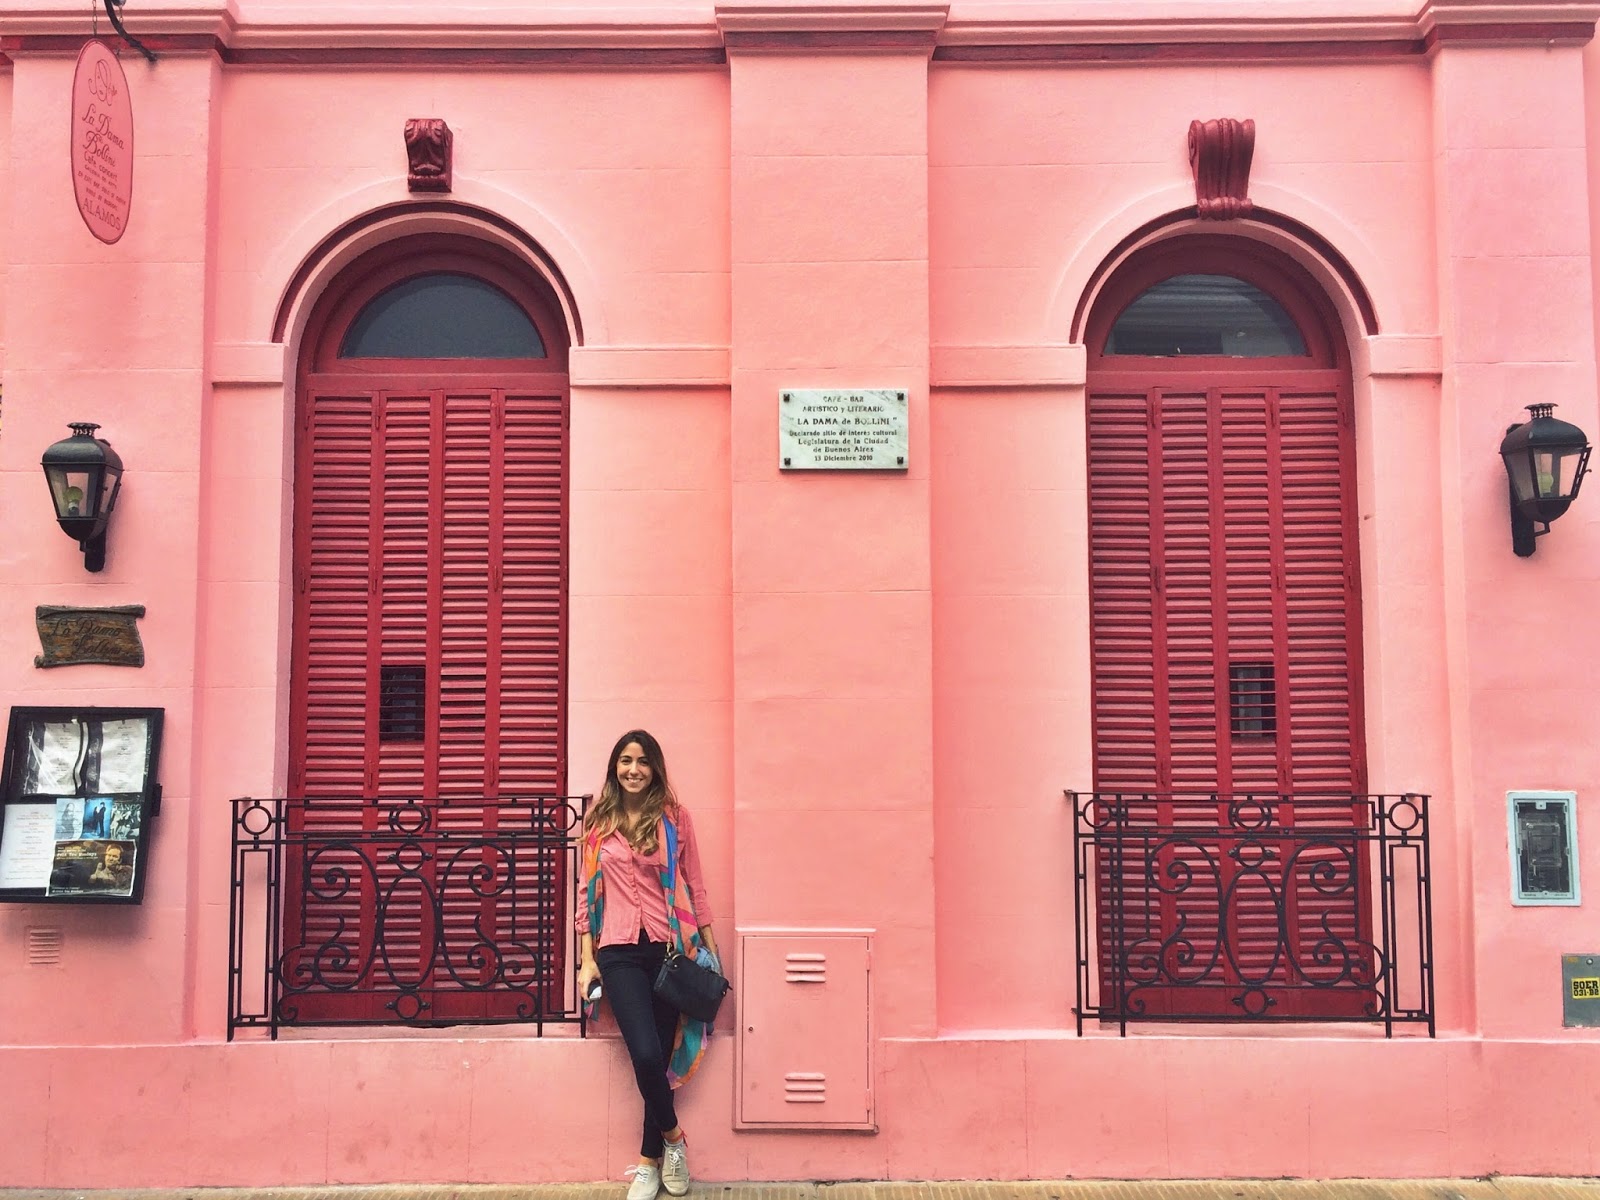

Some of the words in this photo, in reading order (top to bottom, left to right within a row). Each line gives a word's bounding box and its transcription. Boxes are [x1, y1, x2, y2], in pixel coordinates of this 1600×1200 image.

[82, 103, 96, 126] La
[96, 113, 124, 150] Dama
[849, 395, 864, 403] BAR
[812, 417, 838, 425] DAMA
[841, 417, 851, 425] de
[822, 429, 837, 437] sitio
[838, 429, 846, 437] de
[872, 429, 898, 437] cultural
[798, 438, 840, 446] Legislatura
